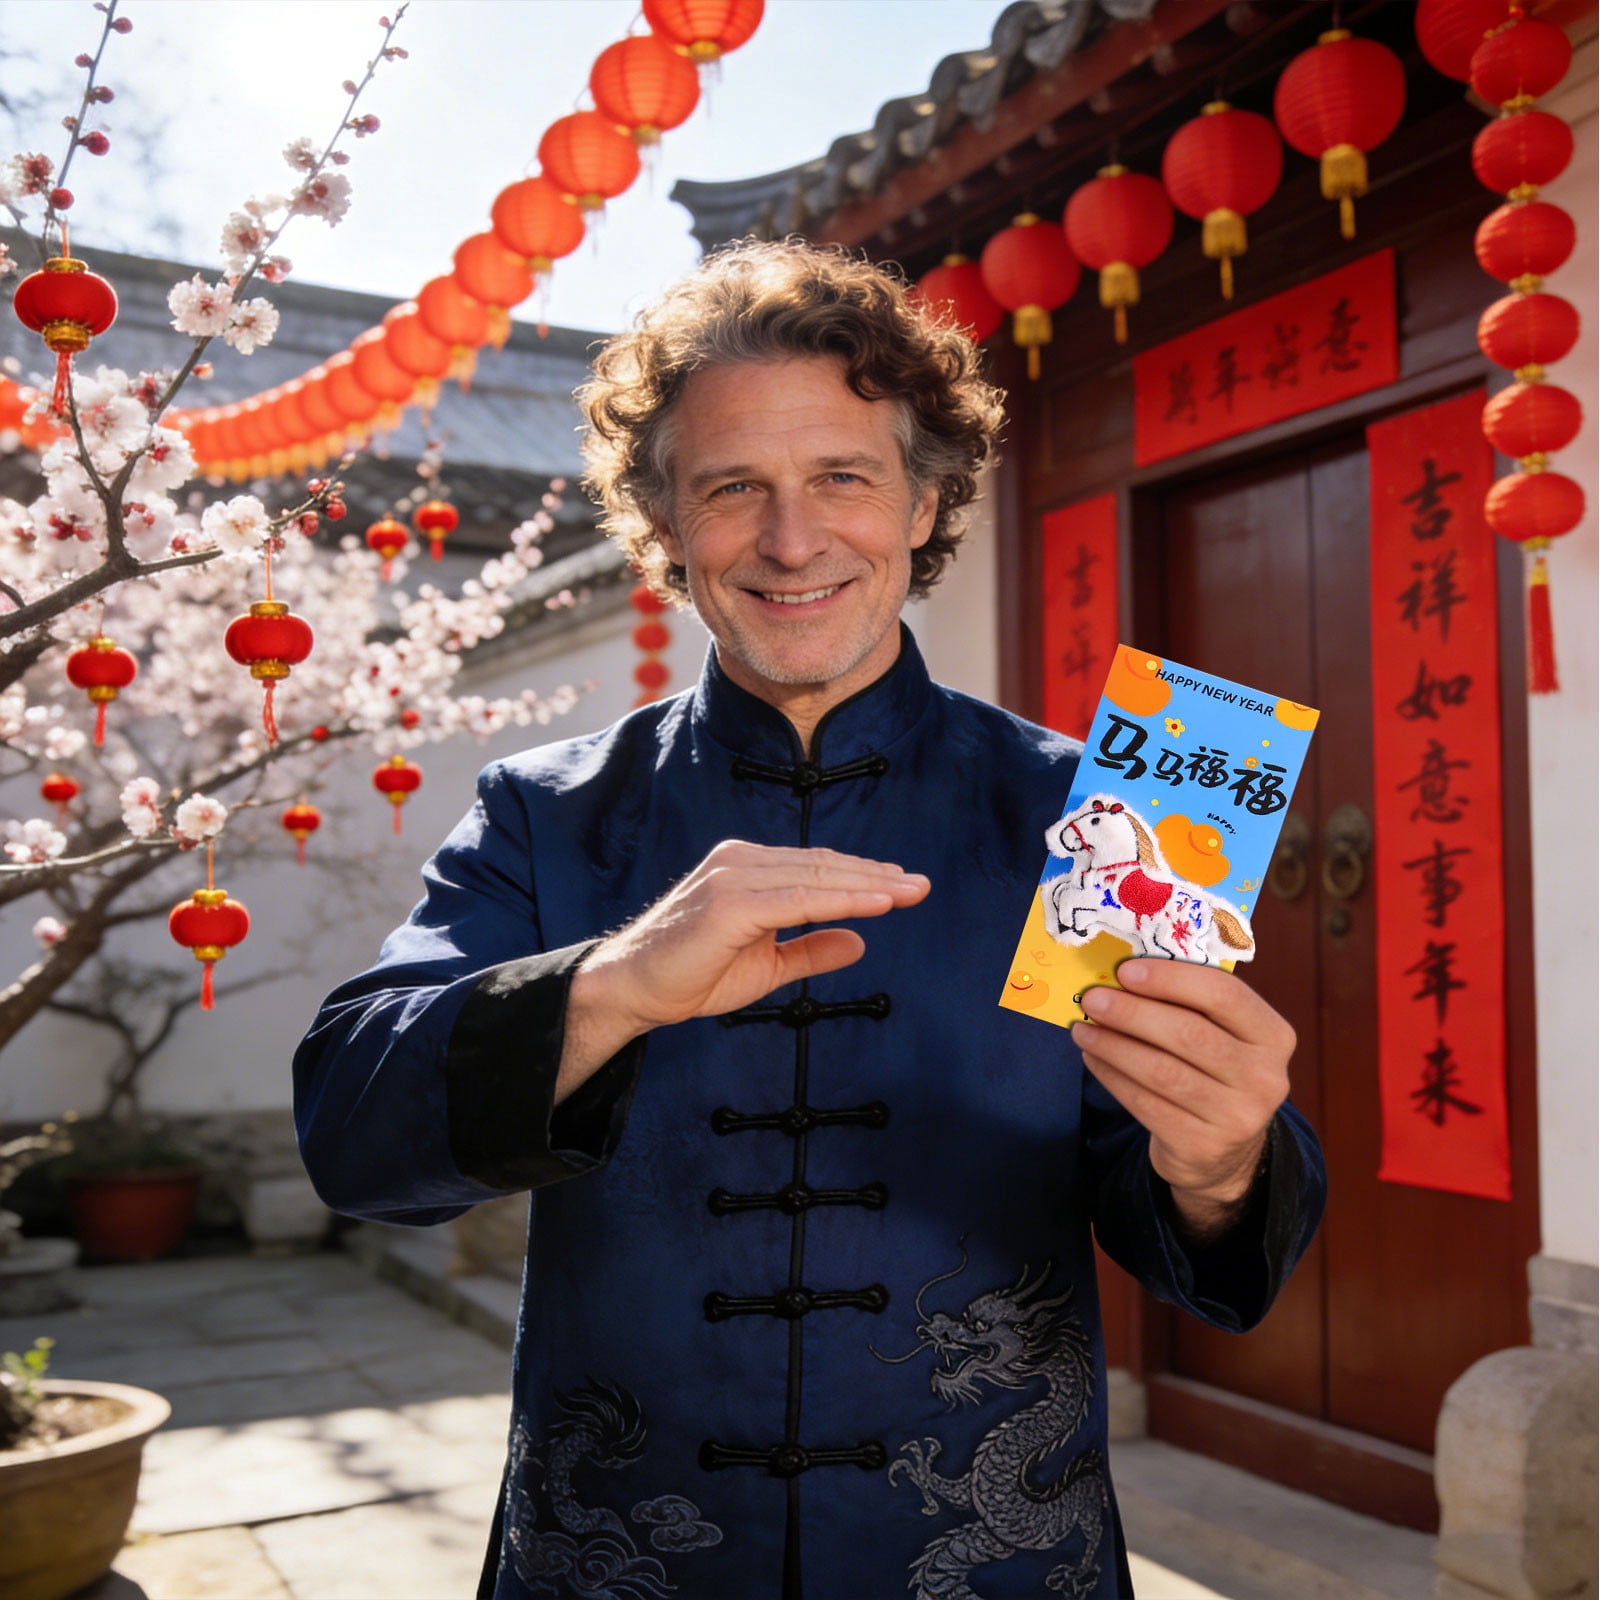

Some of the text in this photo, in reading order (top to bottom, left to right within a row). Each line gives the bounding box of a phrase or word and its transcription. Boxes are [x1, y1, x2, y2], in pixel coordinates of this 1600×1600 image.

[1155, 669, 1274, 717] HAPPY NEW YEAR
[1093, 713, 1288, 816] 马马福福
